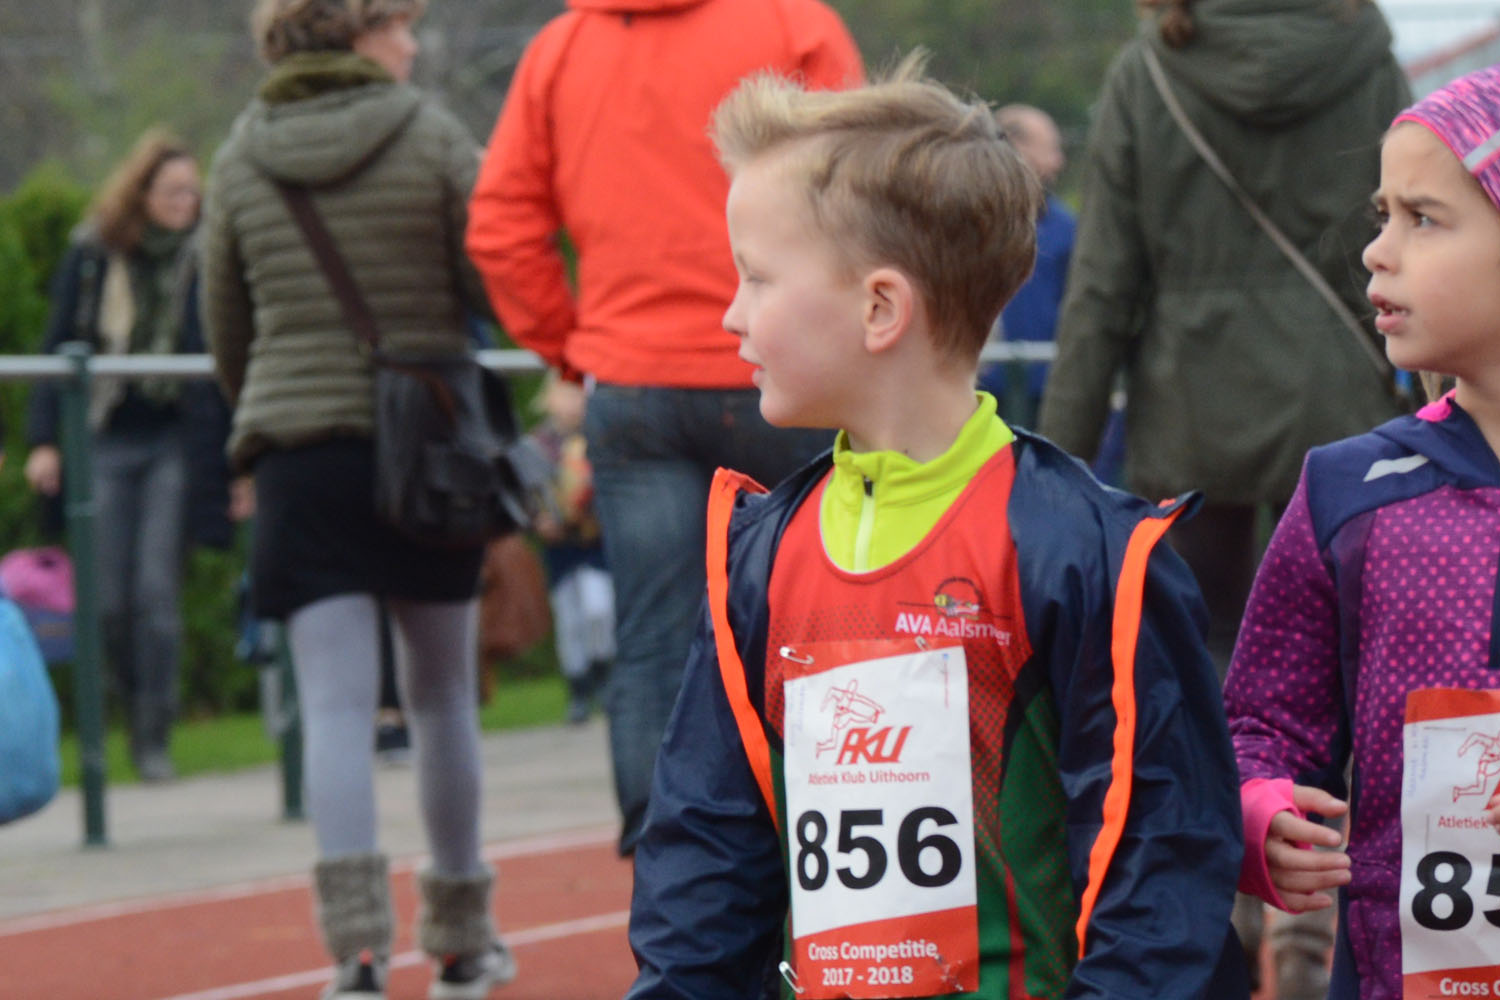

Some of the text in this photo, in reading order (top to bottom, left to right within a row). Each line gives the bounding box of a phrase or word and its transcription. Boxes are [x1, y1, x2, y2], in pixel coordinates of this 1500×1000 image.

[895, 612, 1012, 646] AVA Aalsmer
[835, 725, 914, 766] AKU
[841, 771, 866, 785] Klub
[870, 769, 931, 784] Uithoorn
[1437, 814, 1489, 830] Atletiek
[796, 806, 962, 891] 856
[808, 940, 938, 963] Cross Competitie
[822, 968, 854, 986] 2017
[867, 967, 914, 986] 2018
[1439, 977, 1489, 996] Cross
